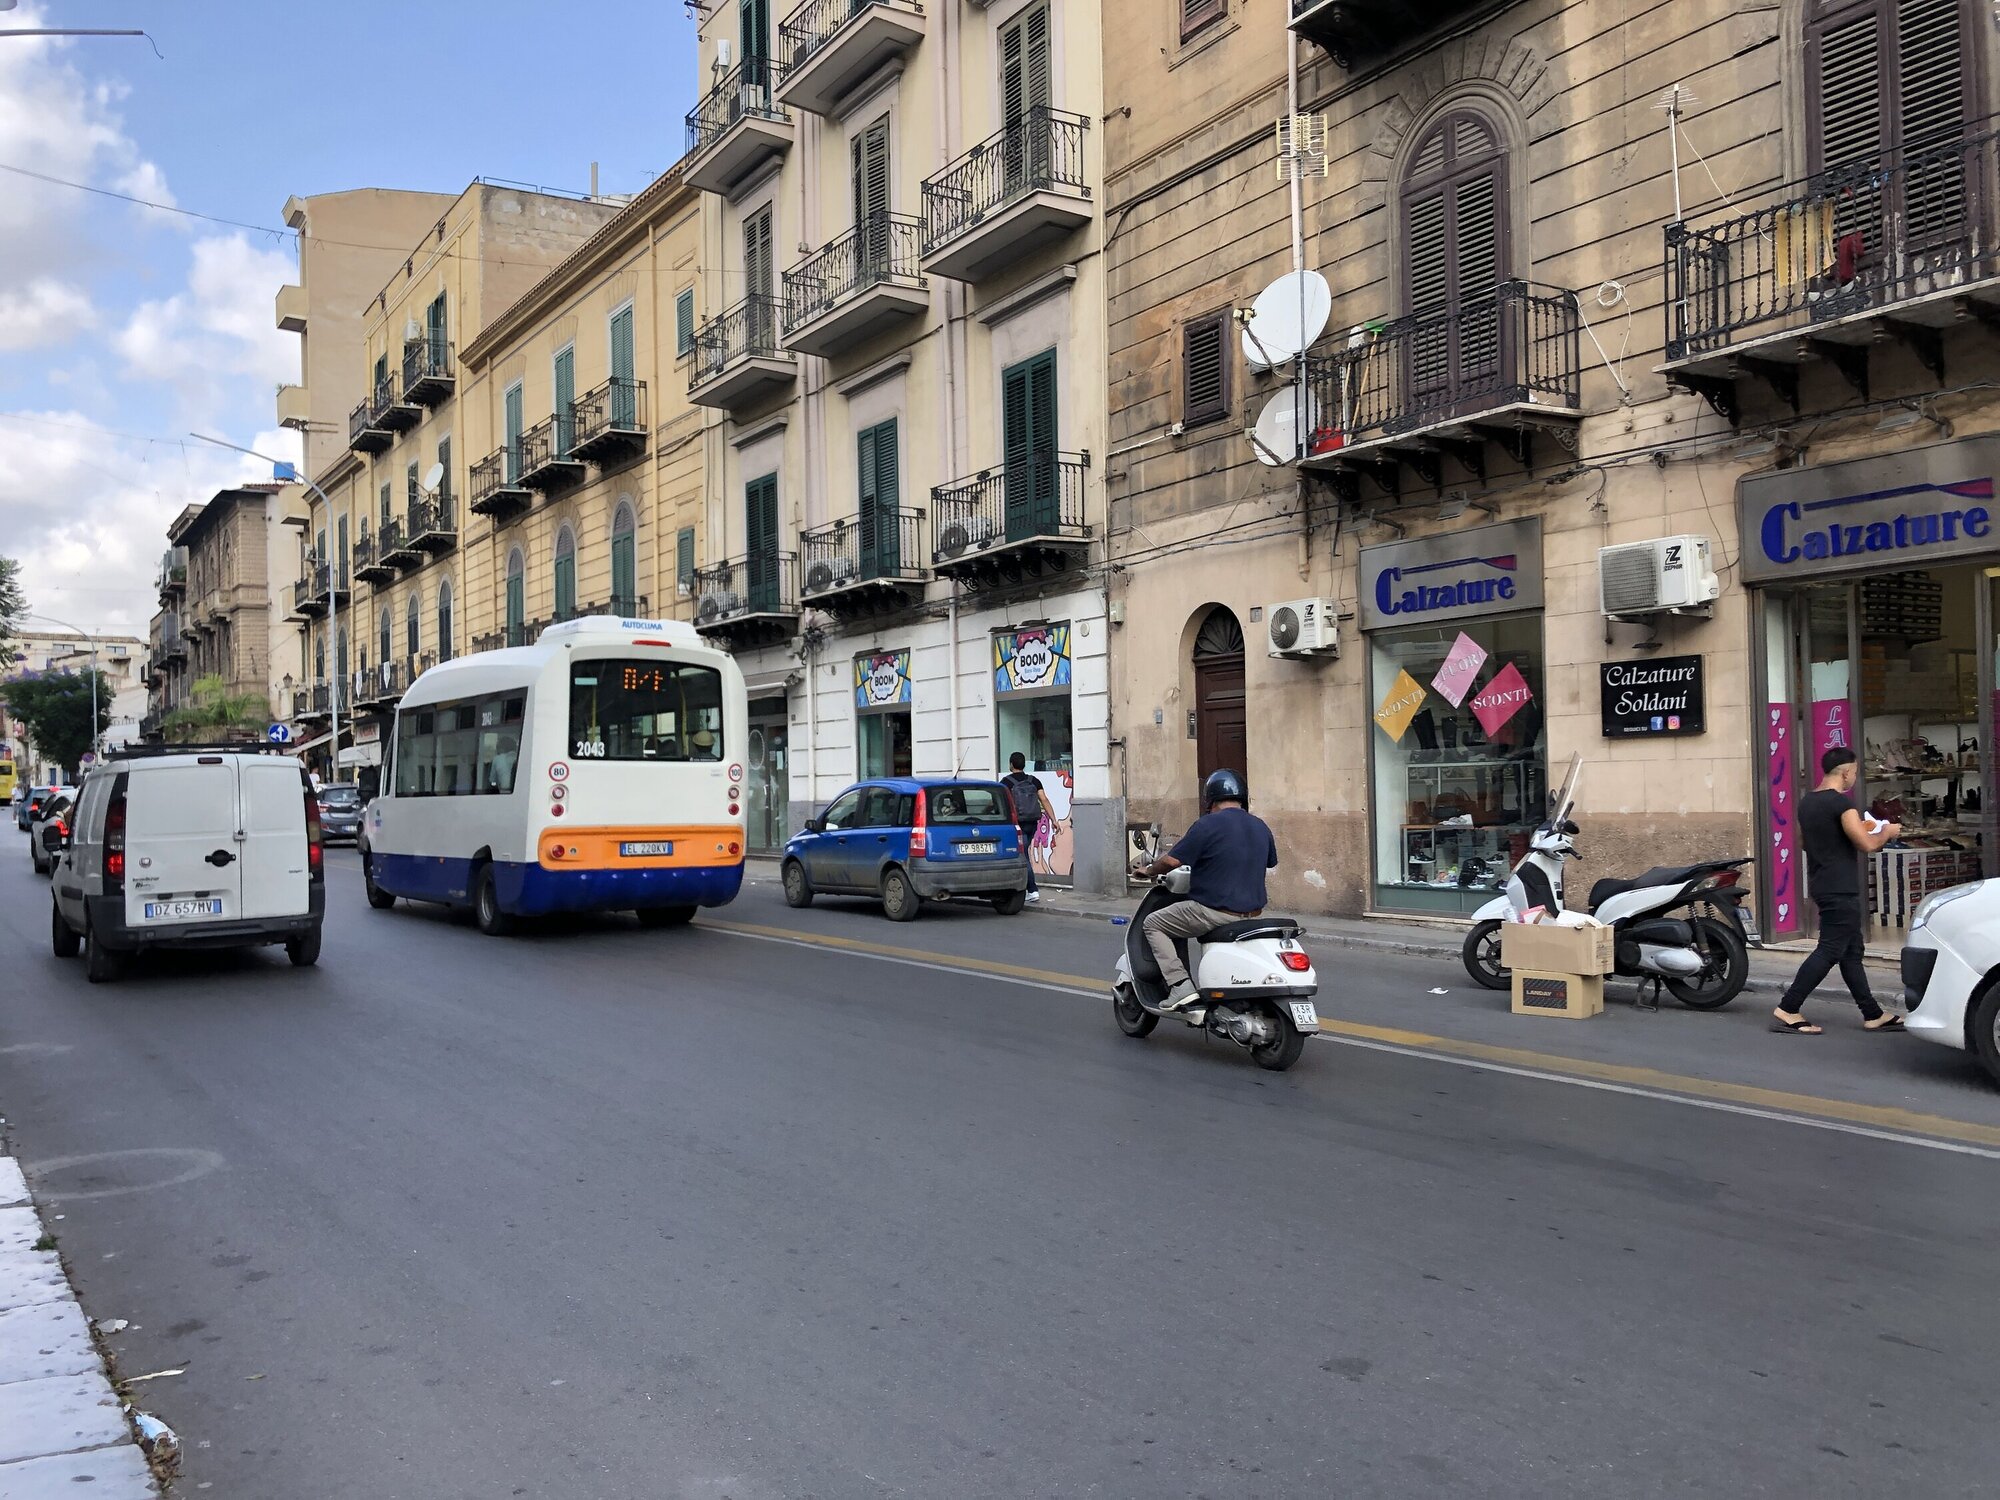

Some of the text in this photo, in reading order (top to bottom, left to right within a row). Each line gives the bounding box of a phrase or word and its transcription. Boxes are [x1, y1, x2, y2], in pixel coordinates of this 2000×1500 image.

[1761, 501, 1992, 564] Calzature
[1375, 567, 1516, 615] Calzature
[622, 621, 663, 631] AUTOCLIMA
[1020, 652, 1046, 668] BOOM
[875, 674, 894, 687] BOOM
[1606, 665, 1695, 687] Calzature
[1377, 689, 1423, 722] SCONTI
[1473, 687, 1529, 710] SCONTI
[1615, 690, 1687, 715] Soldani
[576, 741, 605, 757] 2043
[553, 767, 565, 776] 80
[731, 768, 741, 777] 100
[627, 843, 668, 854] EL 220KV
[960, 844, 969, 853] CP
[155, 901, 213, 916] DZ 657MV
[1297, 1014, 1316, 1024] 9LK
